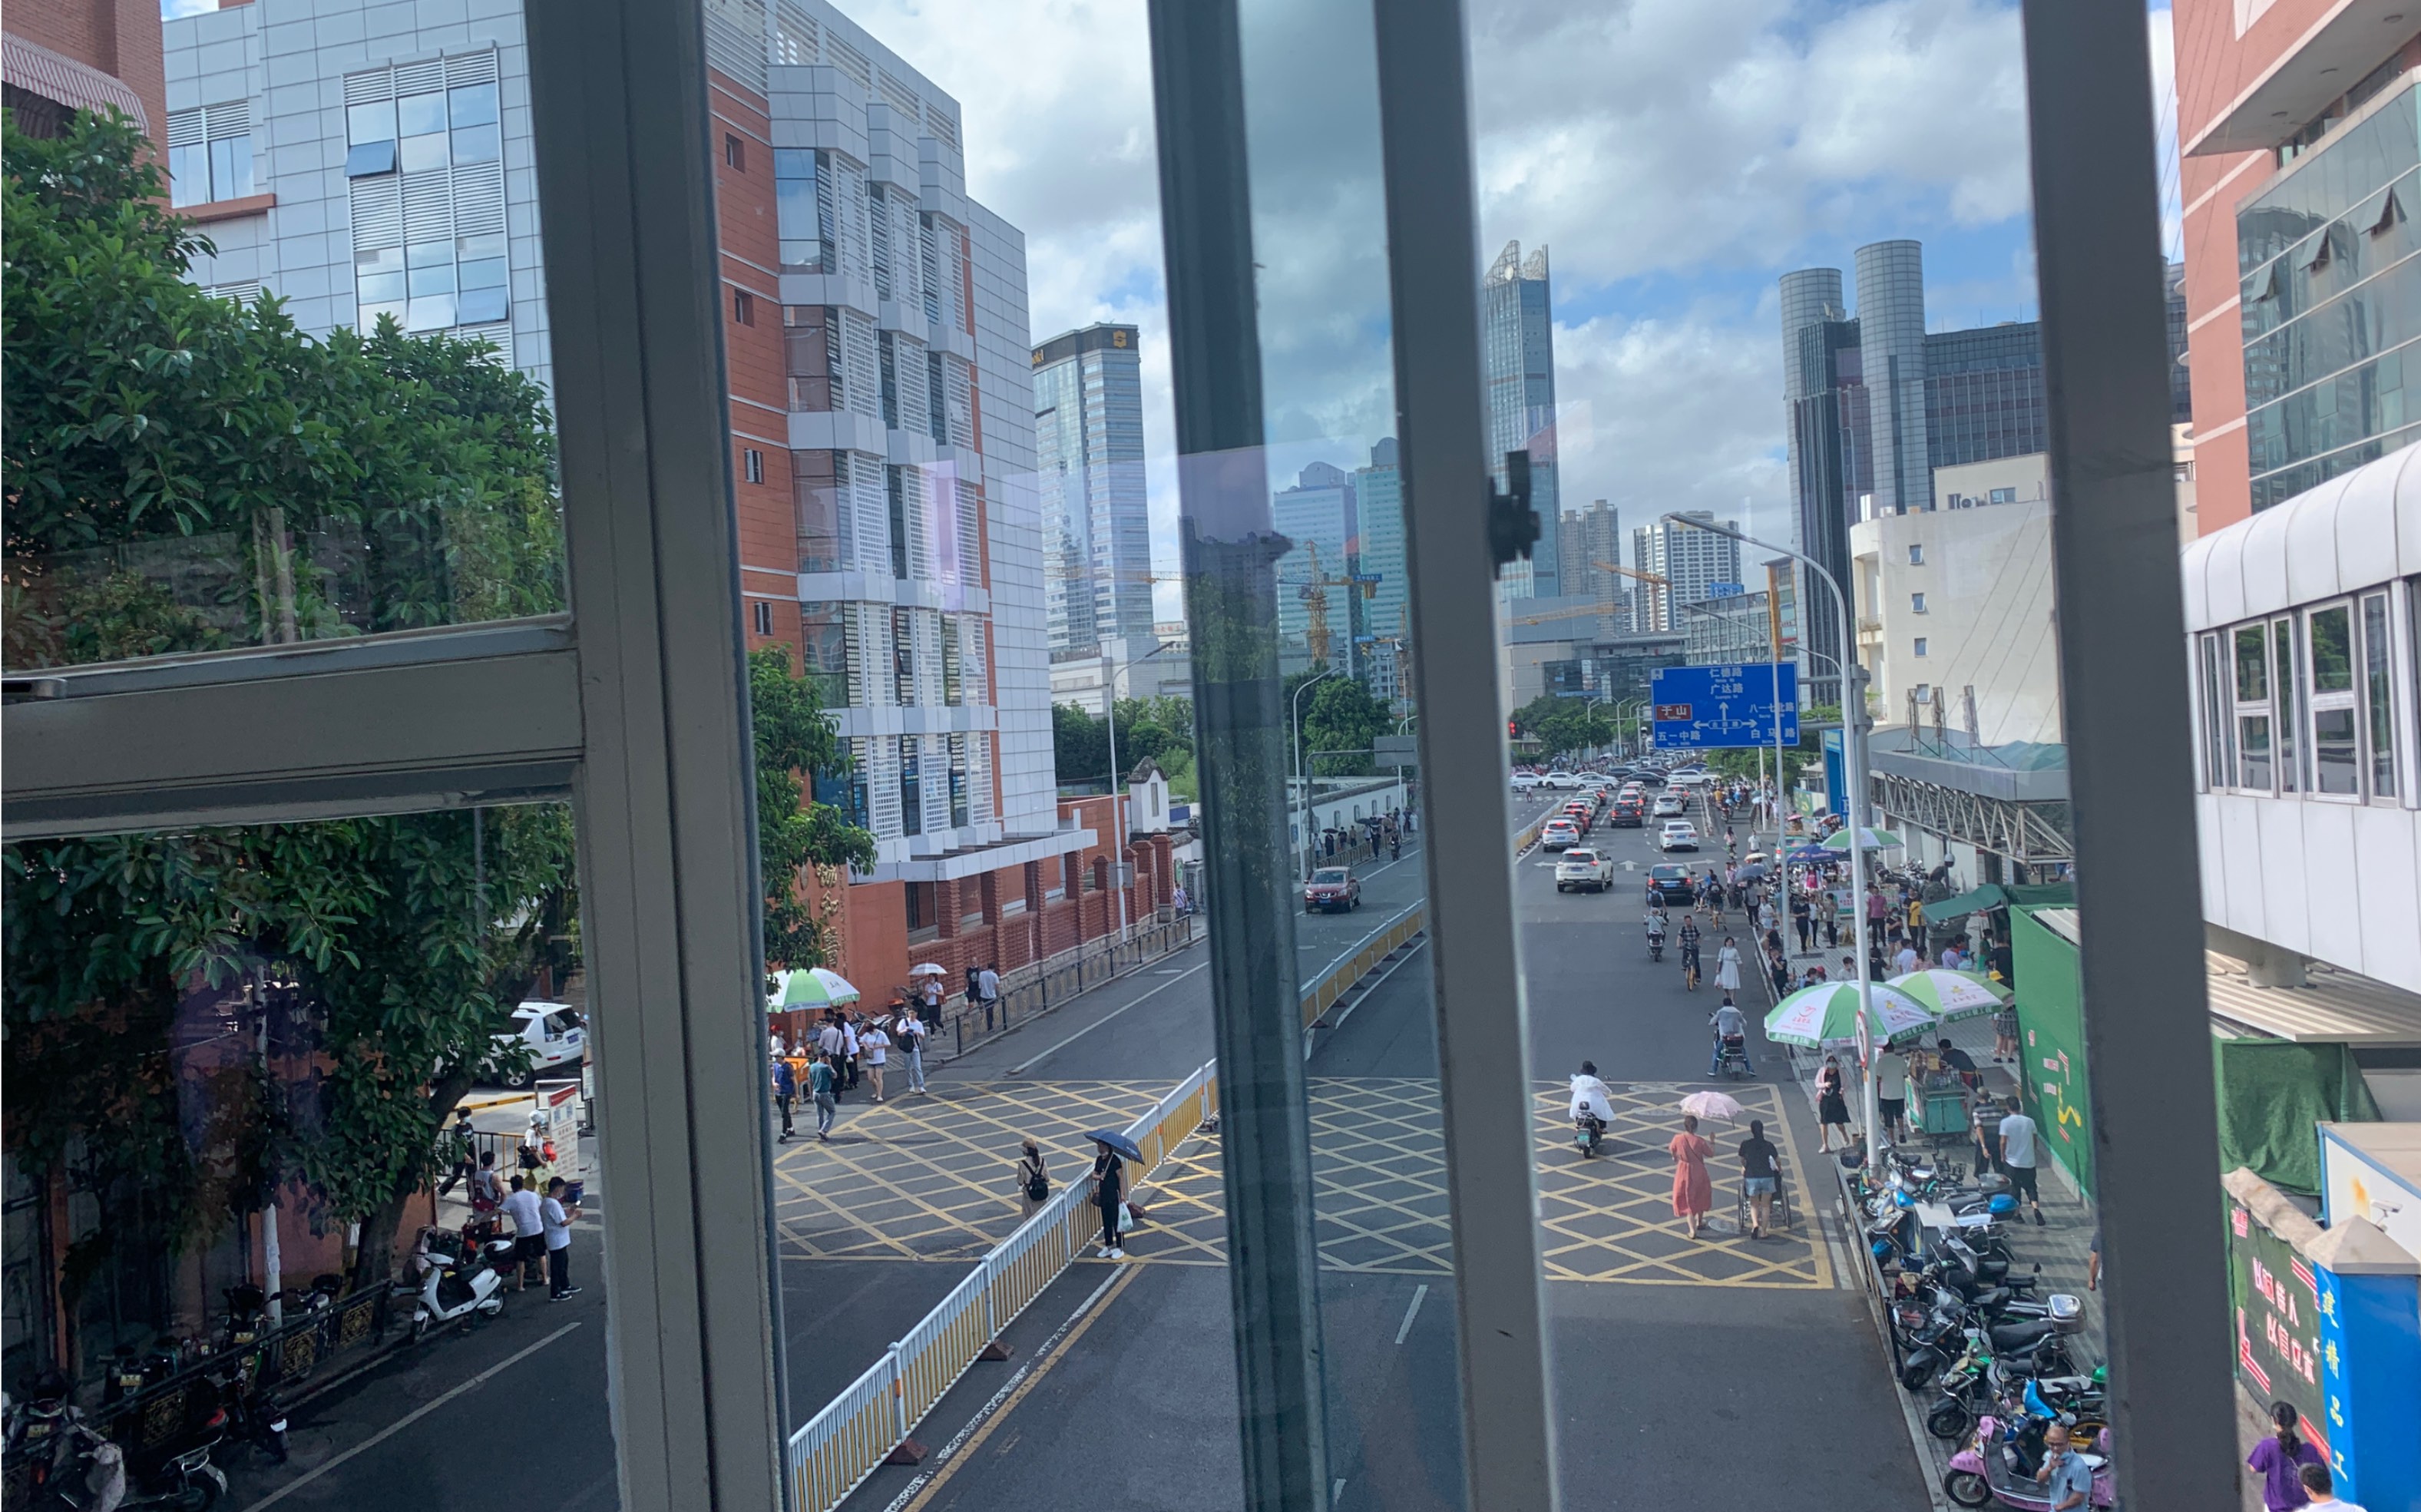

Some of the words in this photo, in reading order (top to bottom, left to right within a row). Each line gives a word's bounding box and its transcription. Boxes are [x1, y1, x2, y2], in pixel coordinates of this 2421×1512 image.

[1709, 667, 1742, 678] 仁德路
[1710, 683, 1743, 694] 广达路
[1661, 705, 1687, 716] 于山
[1657, 730, 1701, 741] 五一中路
